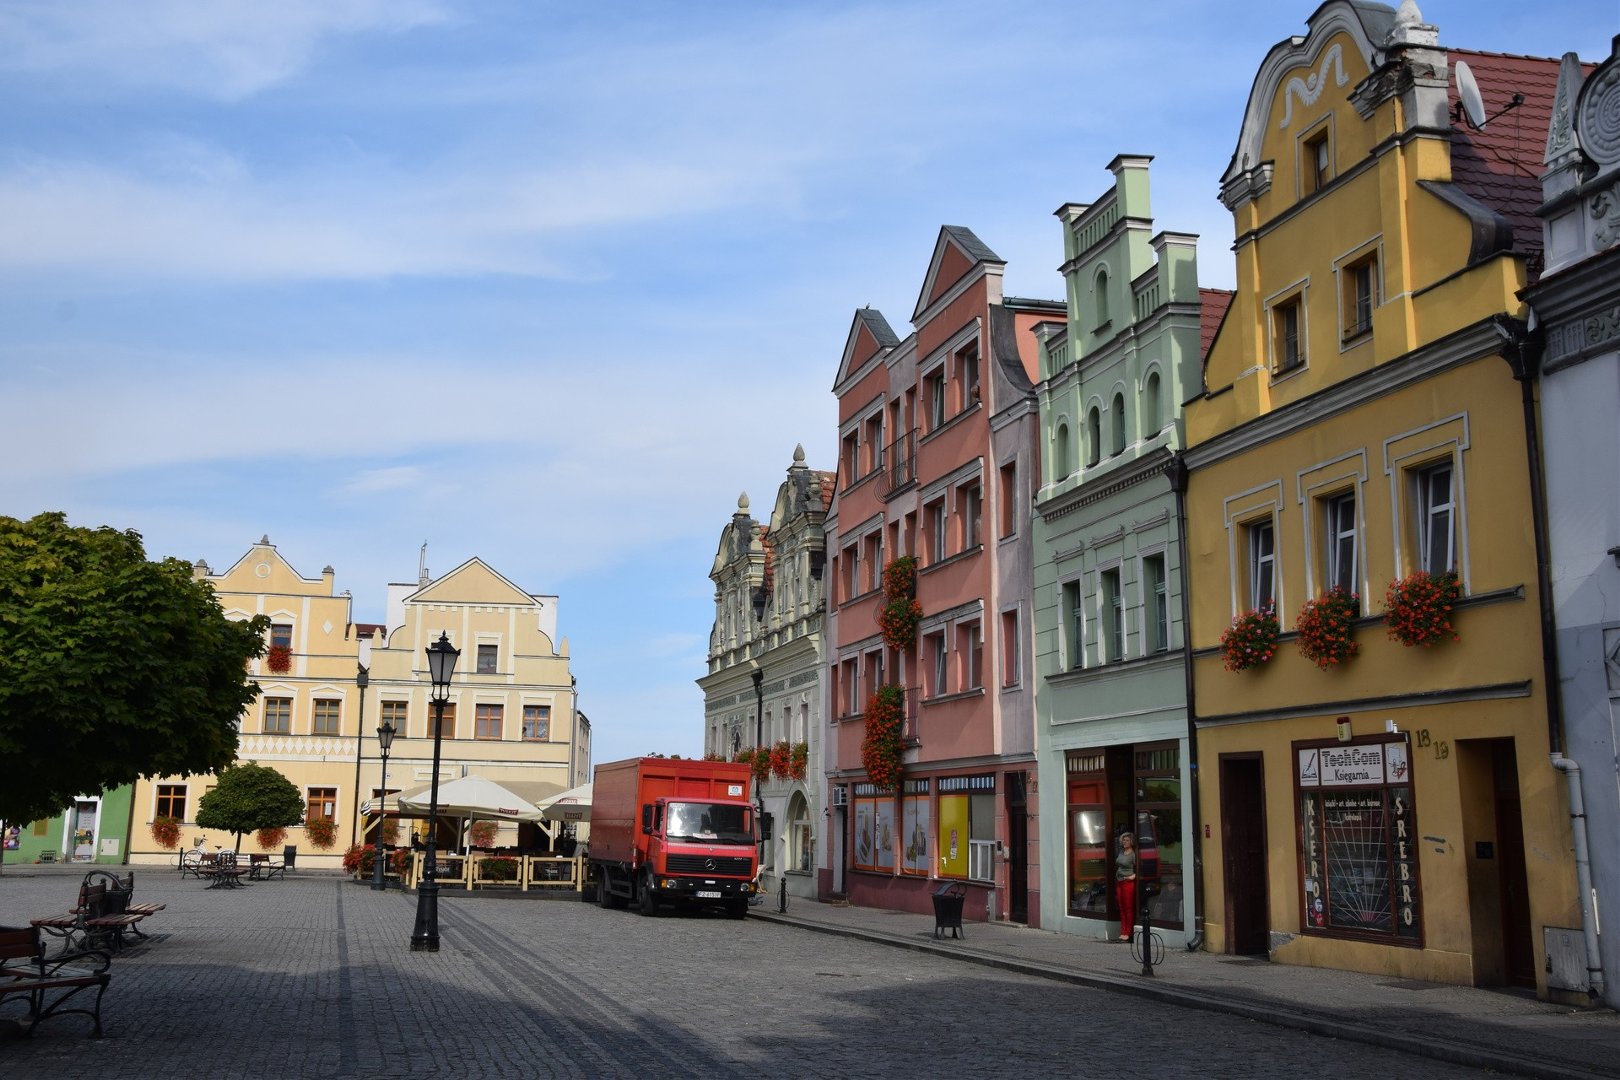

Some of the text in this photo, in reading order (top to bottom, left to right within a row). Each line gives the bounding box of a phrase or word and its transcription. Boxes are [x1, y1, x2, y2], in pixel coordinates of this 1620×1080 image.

[1416, 729, 1431, 748] 18
[1321, 748, 1381, 768] TechCom
[1433, 740, 1449, 760] 19
[1334, 768, 1370, 783] Księgarnia
[1307, 799, 1320, 898] KSERO
[1395, 796, 1413, 927] SREBRO
